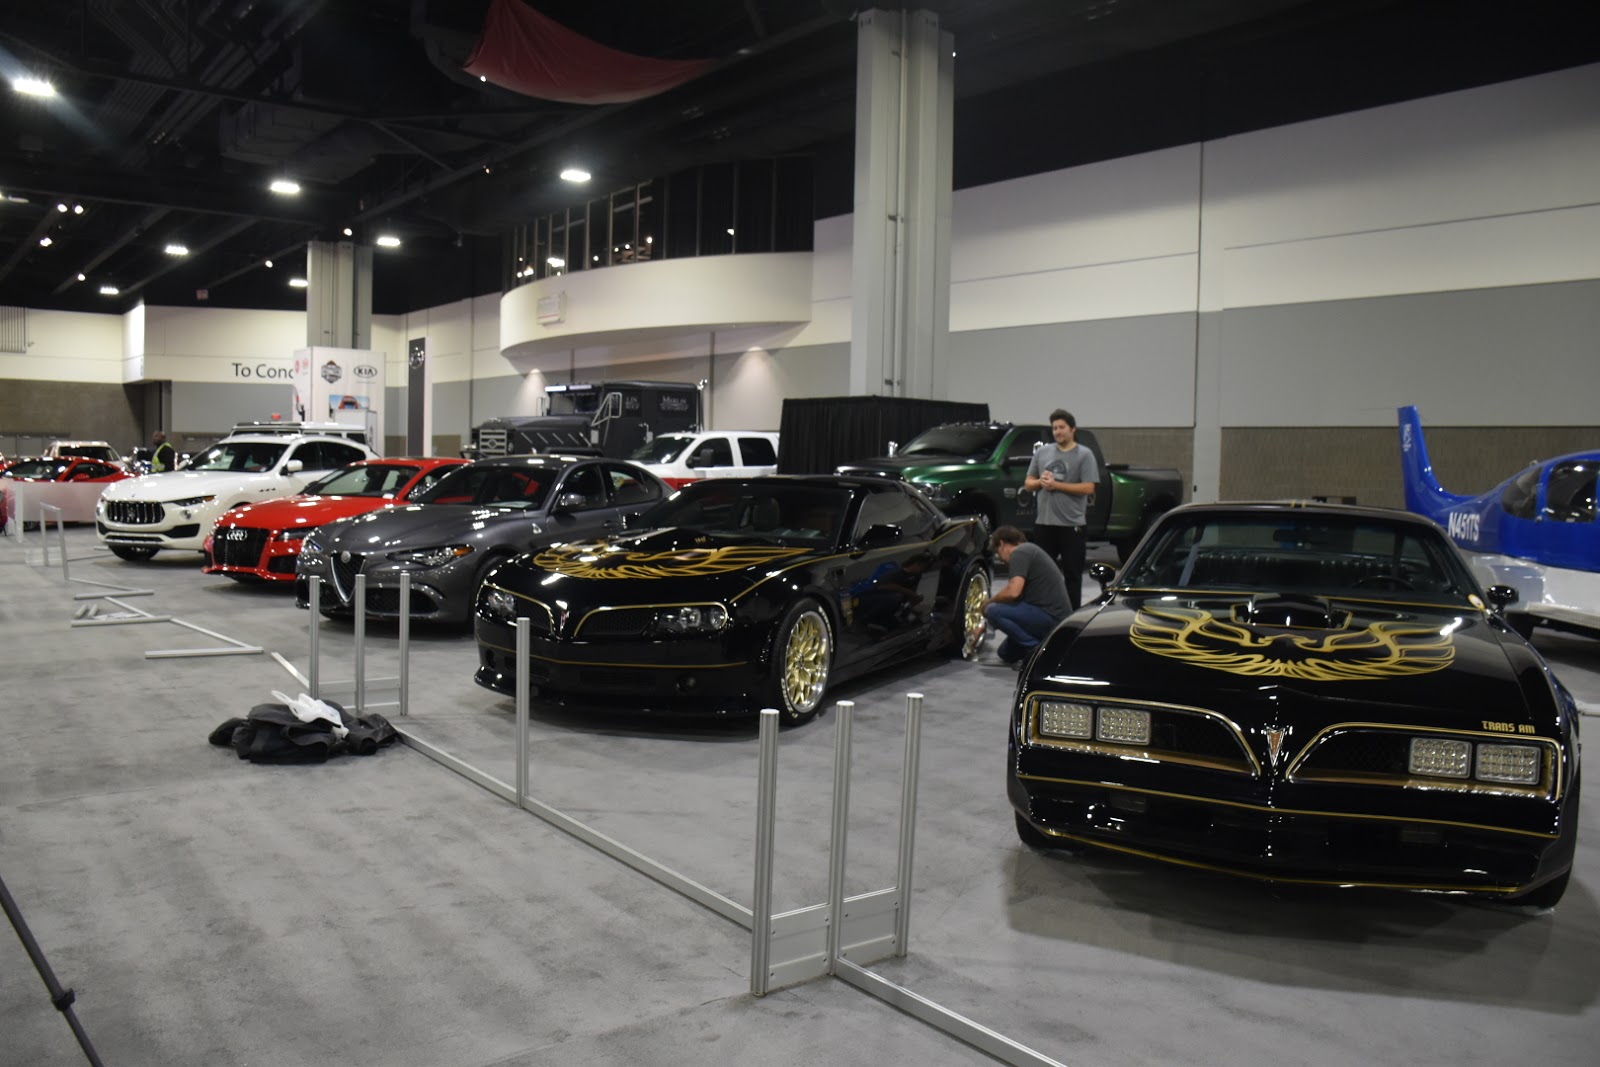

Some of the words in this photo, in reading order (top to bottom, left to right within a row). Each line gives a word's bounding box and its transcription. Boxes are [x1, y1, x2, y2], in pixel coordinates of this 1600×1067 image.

[232, 362, 251, 378] To
[357, 368, 374, 376] KIA
[1448, 512, 1480, 542] N451TS
[1481, 720, 1515, 732] TRANS
[1518, 724, 1535, 734] AM
